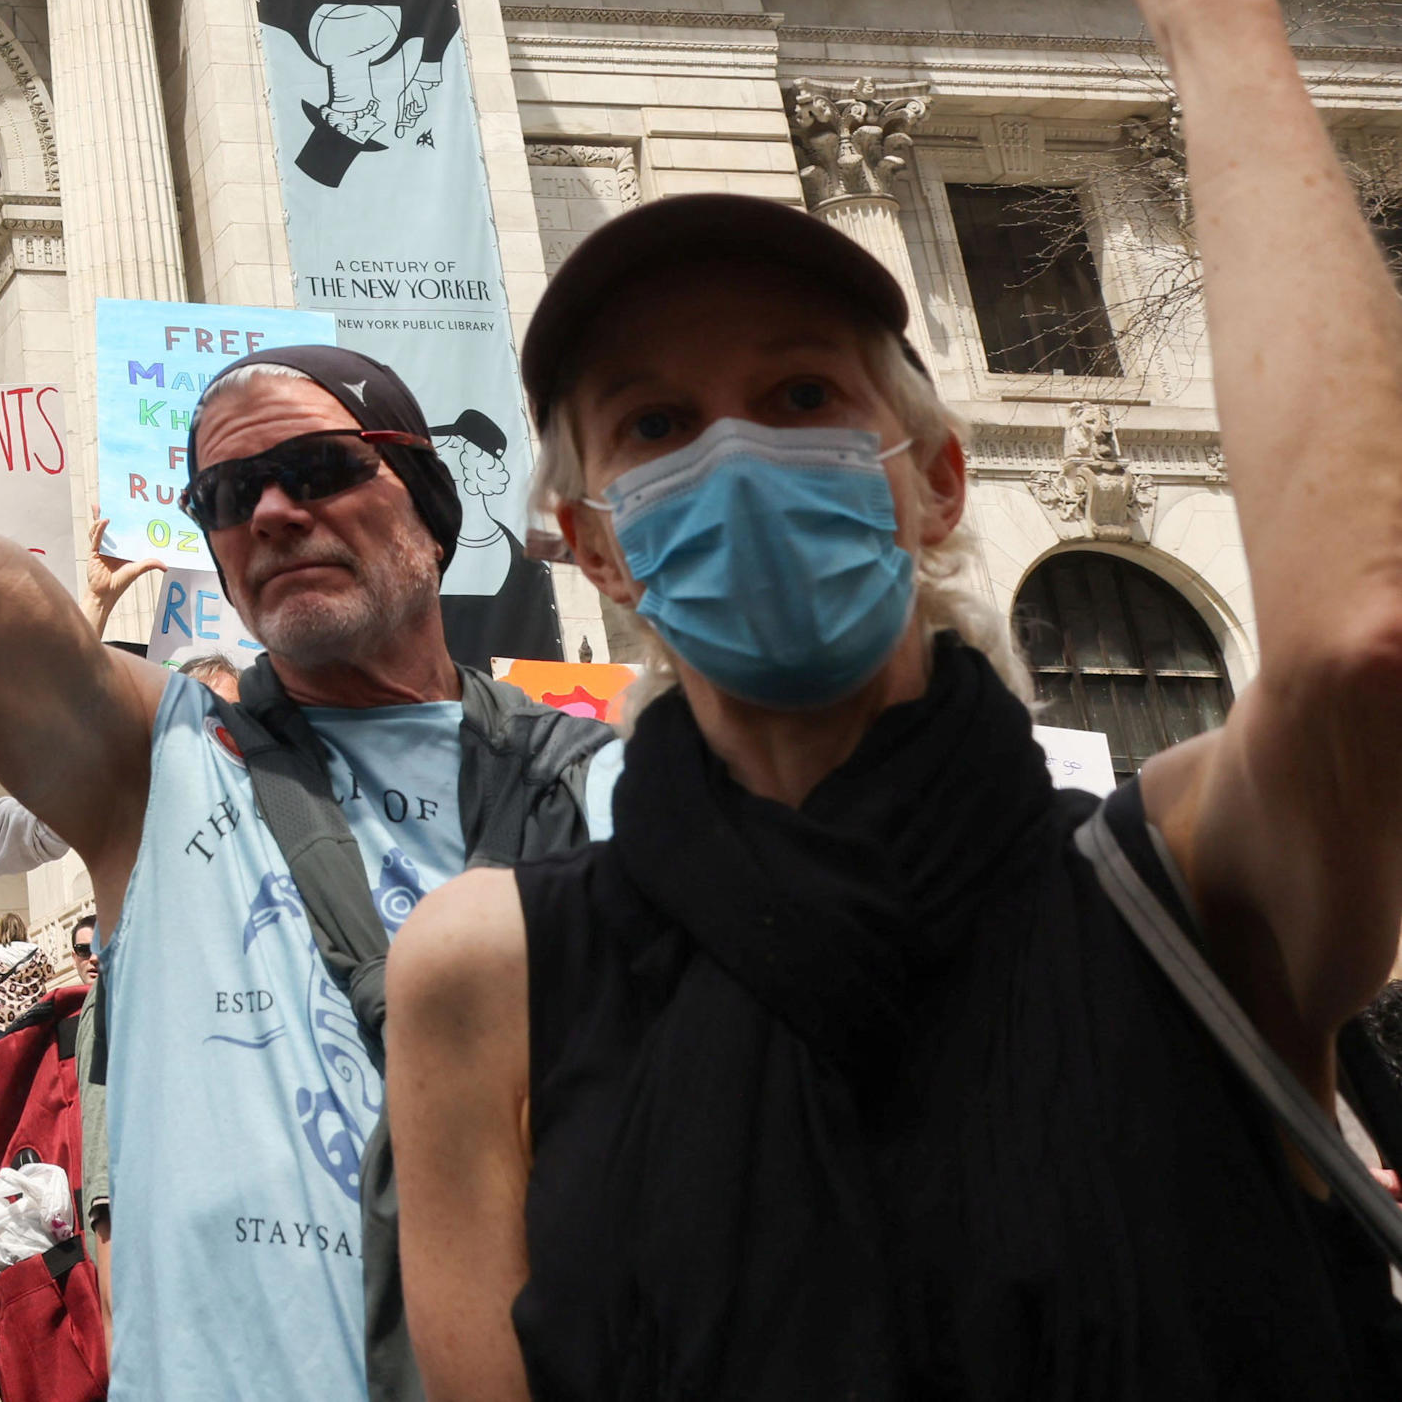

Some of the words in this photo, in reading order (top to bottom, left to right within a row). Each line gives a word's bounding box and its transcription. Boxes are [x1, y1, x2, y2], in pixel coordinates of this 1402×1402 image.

[335, 260, 345, 272] A
[349, 260, 429, 273] CENTURY
[434, 261, 456, 273] OF
[305, 276, 346, 298] THE
[352, 278, 400, 299] NEW
[405, 278, 492, 301] YORKER
[338, 318, 364, 329] NEW
[367, 319, 399, 330] YORK
[403, 320, 445, 331] PUBLIC
[448, 321, 494, 332] LIBRARY
[383, 788, 438, 823] OF
[215, 989, 274, 1014] ESTD
[234, 1217, 364, 1259] STAYSA
